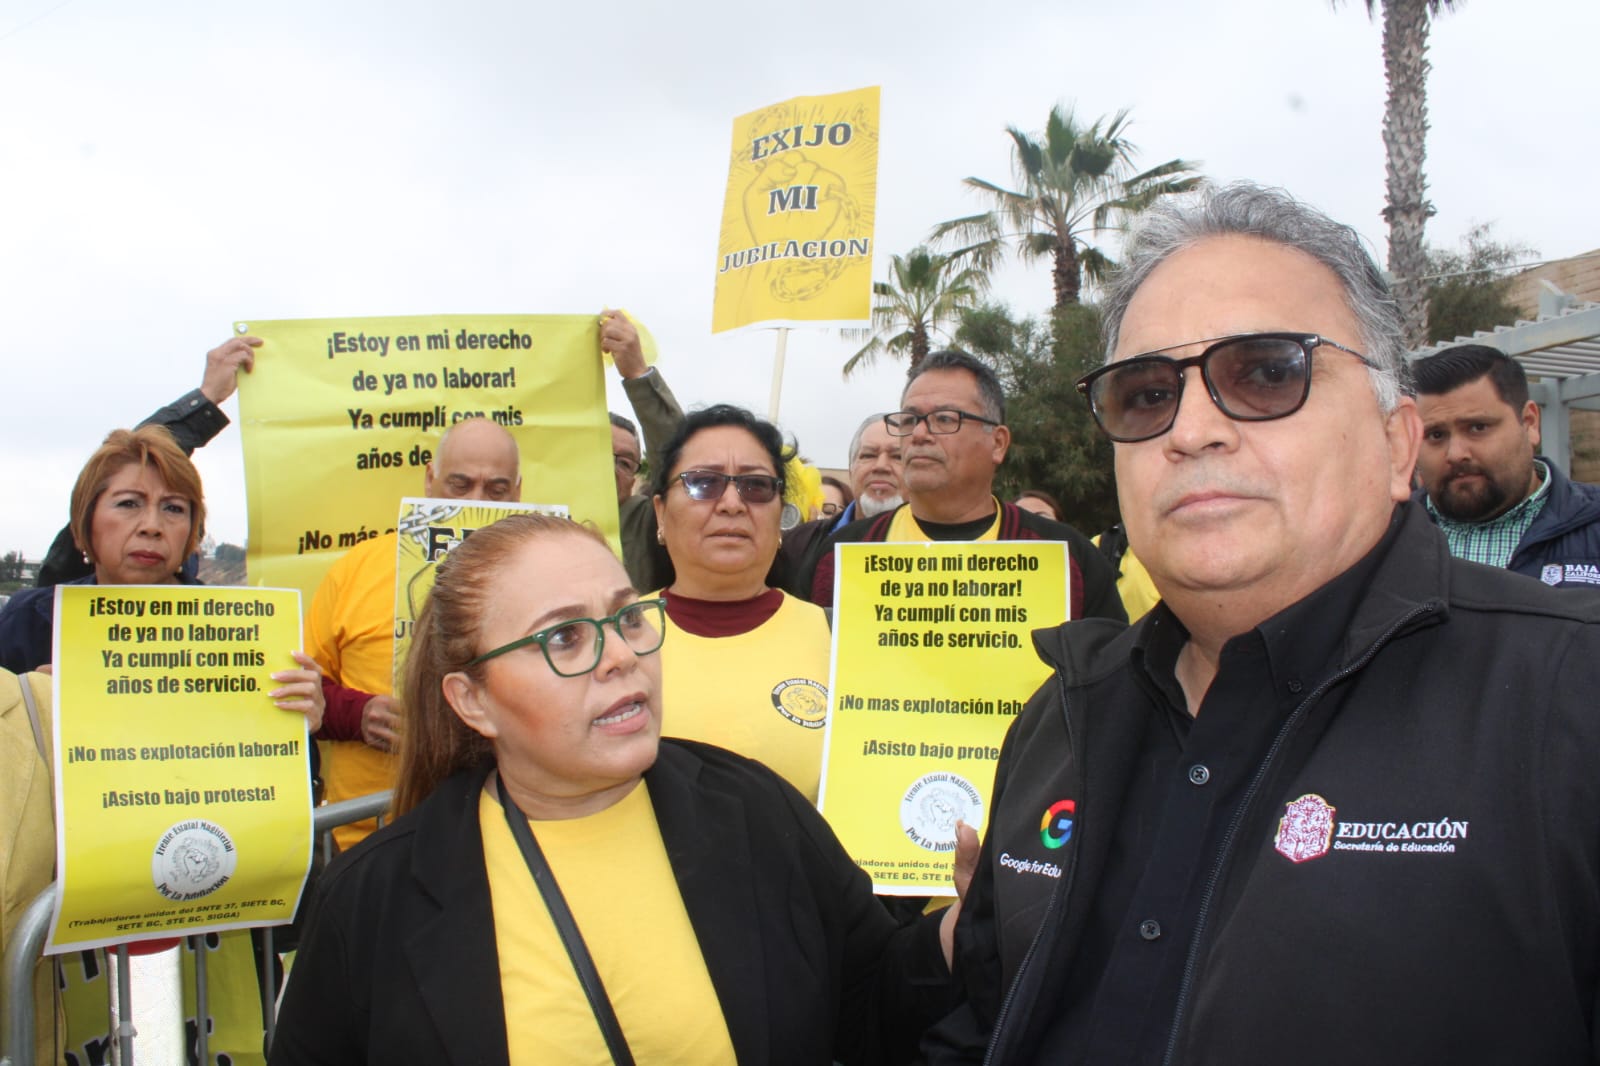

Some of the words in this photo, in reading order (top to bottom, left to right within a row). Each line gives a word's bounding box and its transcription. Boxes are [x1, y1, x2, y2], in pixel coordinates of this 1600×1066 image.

[751, 122, 852, 161] EXIJO
[767, 185, 818, 215] MI
[719, 238, 870, 272] JUBILACION
[327, 331, 390, 360] ¡Estoy
[396, 334, 420, 352] en
[426, 329, 449, 350] mi
[455, 329, 532, 351] derecho
[352, 370, 378, 392] de
[384, 374, 408, 395] ya
[413, 372, 438, 389] no
[443, 367, 516, 390] laborar!
[347, 408, 373, 429] Ya
[379, 405, 446, 432] cumplí
[492, 405, 523, 426] mis
[356, 448, 403, 470] años
[409, 445, 432, 466] de
[298, 530, 332, 555] ¡No
[864, 554, 913, 574] ¡Estoy
[917, 558, 938, 572] en
[942, 554, 962, 572] mi
[967, 553, 1039, 572] derecho
[1565, 564, 1599, 573] BAJA
[880, 579, 901, 597] de
[905, 583, 924, 598] ya
[928, 582, 949, 597] no
[952, 579, 1022, 597] laborar!
[89, 597, 146, 617] ¡Estoy
[150, 601, 172, 616] en
[176, 598, 199, 616] mi
[203, 599, 275, 617] derecho
[875, 604, 893, 622] Ya
[897, 604, 956, 624] cumplí
[959, 607, 991, 622] con
[995, 605, 1027, 623] mis
[108, 624, 131, 642] de
[136, 628, 157, 643] ya
[161, 627, 184, 642] no
[188, 624, 259, 642] laborar!
[878, 629, 919, 647] años
[923, 630, 943, 648] de
[947, 631, 1023, 649] servicio.
[102, 650, 123, 668] Ya
[127, 649, 192, 669] cumplí
[196, 652, 228, 667] con
[233, 649, 265, 667] mis
[106, 675, 153, 695] años
[157, 676, 180, 694] de
[184, 675, 261, 693] servicio.
[839, 695, 864, 712] ¡No
[867, 698, 900, 712] mas
[903, 697, 994, 715] explotación
[998, 699, 1024, 715] lab
[68, 746, 97, 764] ¡No
[101, 747, 137, 762] mas
[141, 742, 236, 762] explotación
[239, 740, 300, 758] laboral!
[863, 740, 916, 757] ¡Asisto
[919, 742, 954, 760] bajo
[102, 790, 161, 809] ¡Asisto
[165, 788, 200, 806] bajo
[204, 786, 276, 804] protesta!
[906, 826, 921, 842] Por
[920, 838, 933, 849] La
[1336, 816, 1469, 839] EDUCACIÓN
[1333, 840, 1384, 851] Secretaría
[1386, 842, 1400, 852] de
[1401, 841, 1456, 853] Educación
[898, 860, 930, 869] unidos
[933, 861, 948, 869] del
[1000, 852, 1032, 874] Google
[1030, 860, 1044, 874] for
[873, 871, 900, 880] SETE
[922, 873, 942, 881] STE
[157, 882, 173, 897] Por
[170, 891, 183, 900] La
[144, 910, 176, 919] unidos
[178, 907, 193, 915] del
[196, 904, 222, 912] SNTE
[116, 922, 144, 931] SETE
[166, 918, 185, 926] STE
